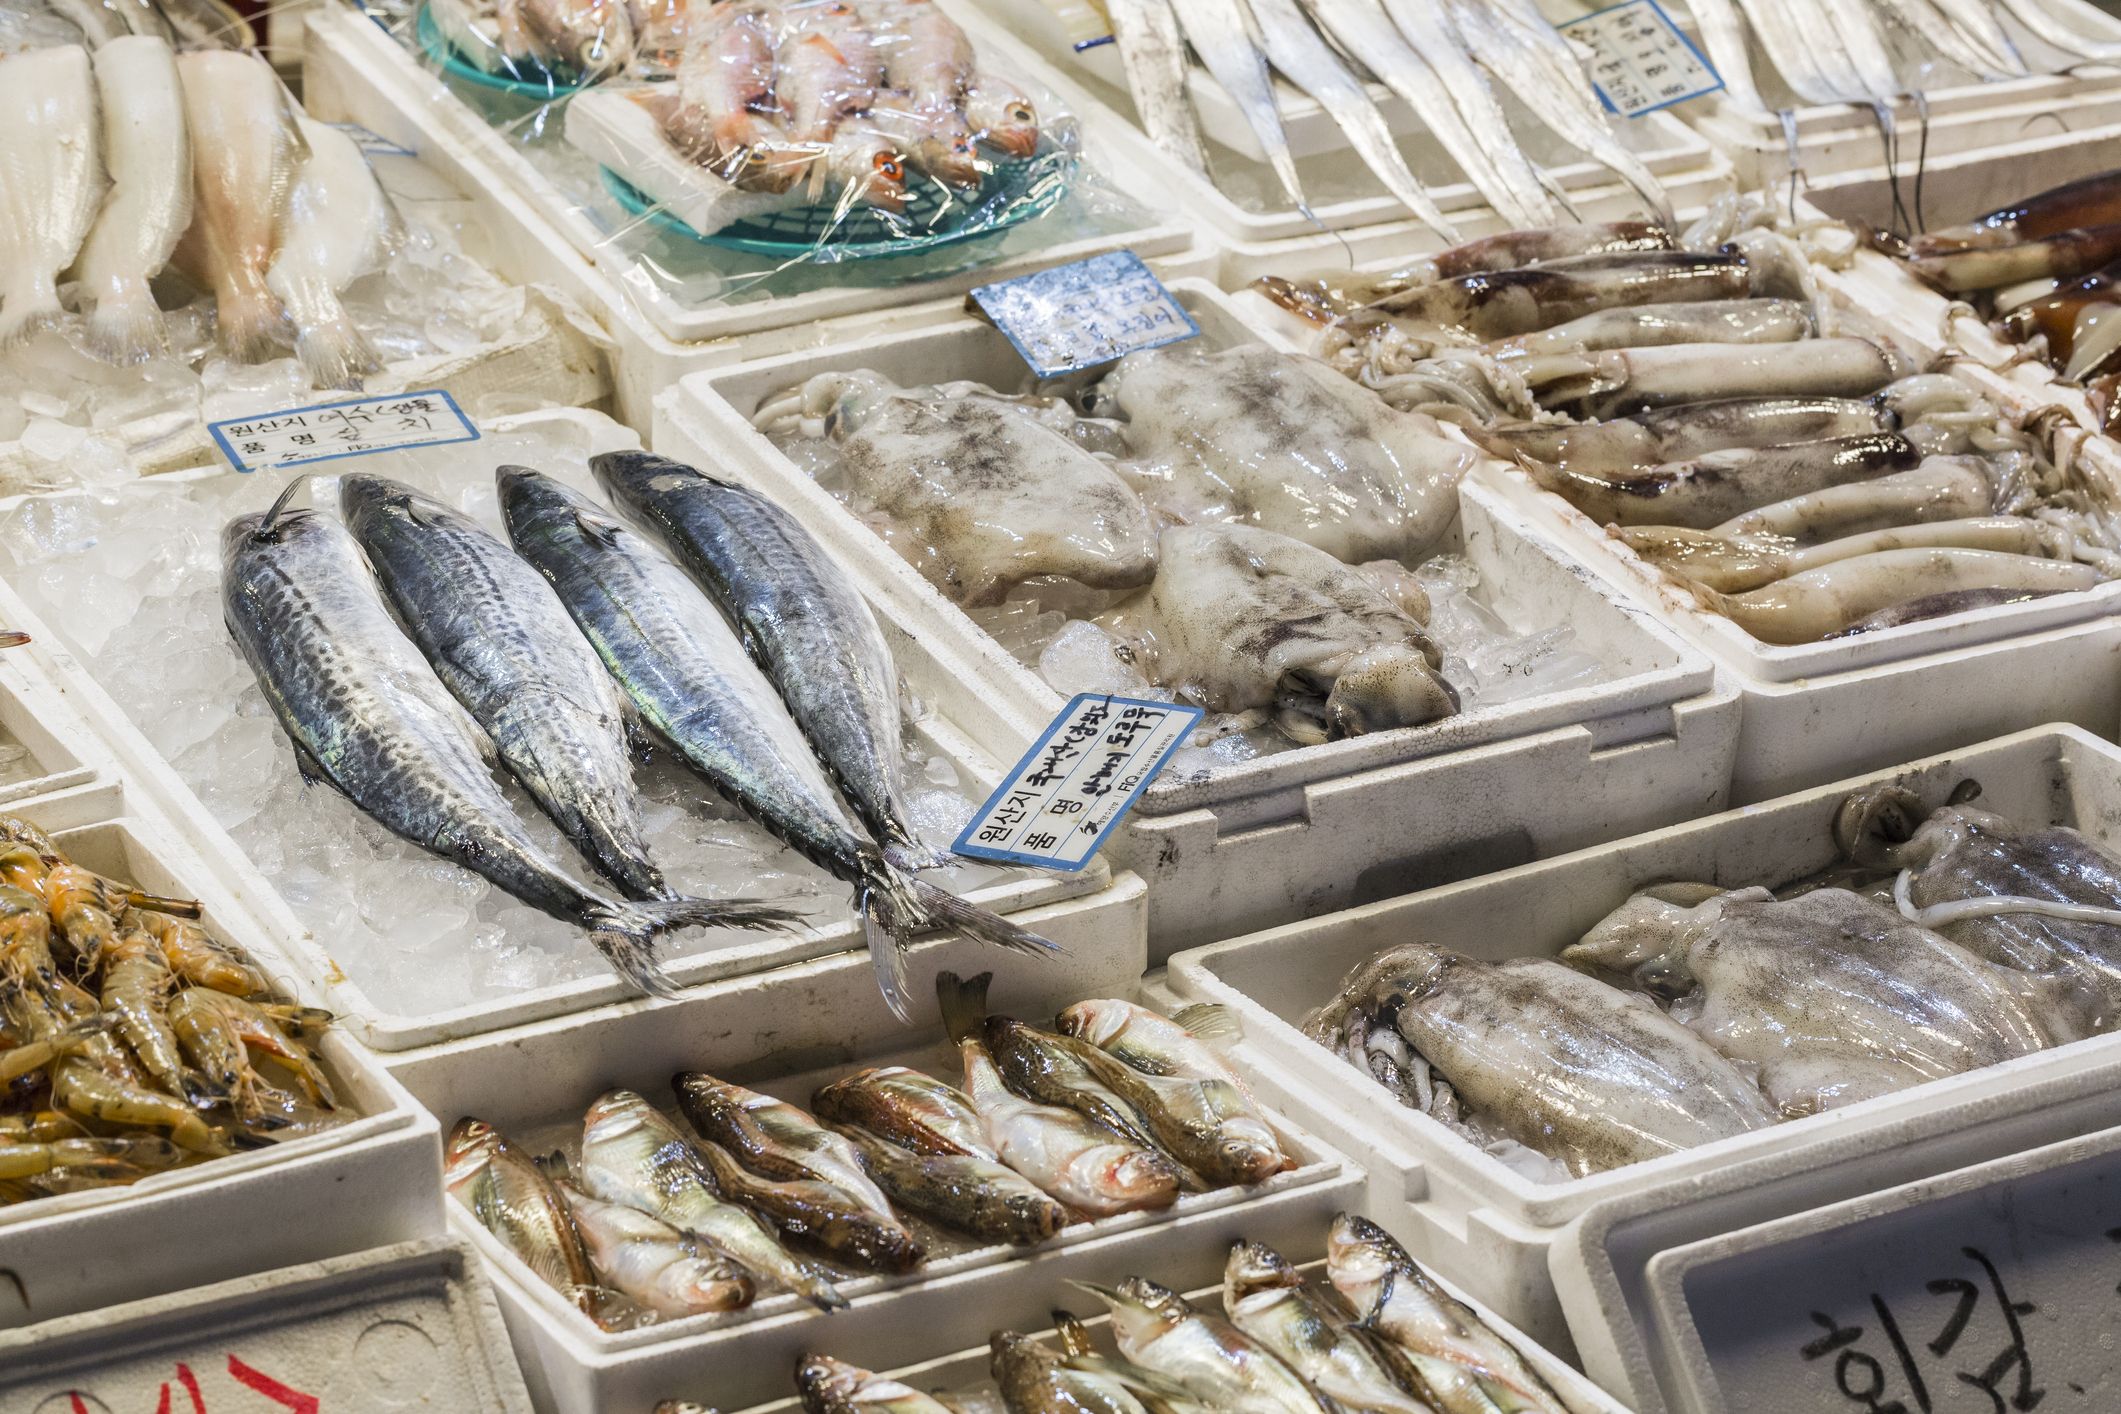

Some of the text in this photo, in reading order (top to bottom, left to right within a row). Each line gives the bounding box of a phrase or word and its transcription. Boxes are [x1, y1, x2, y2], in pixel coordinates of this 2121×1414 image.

[229, 416, 307, 437] 원산지
[241, 442, 266, 454] 품
[290, 433, 316, 445] 명
[1023, 832, 1057, 850] 품
[1050, 799, 1083, 815] 명
[1107, 707, 1166, 747] 도루묵
[978, 790, 1042, 843] 원산지
